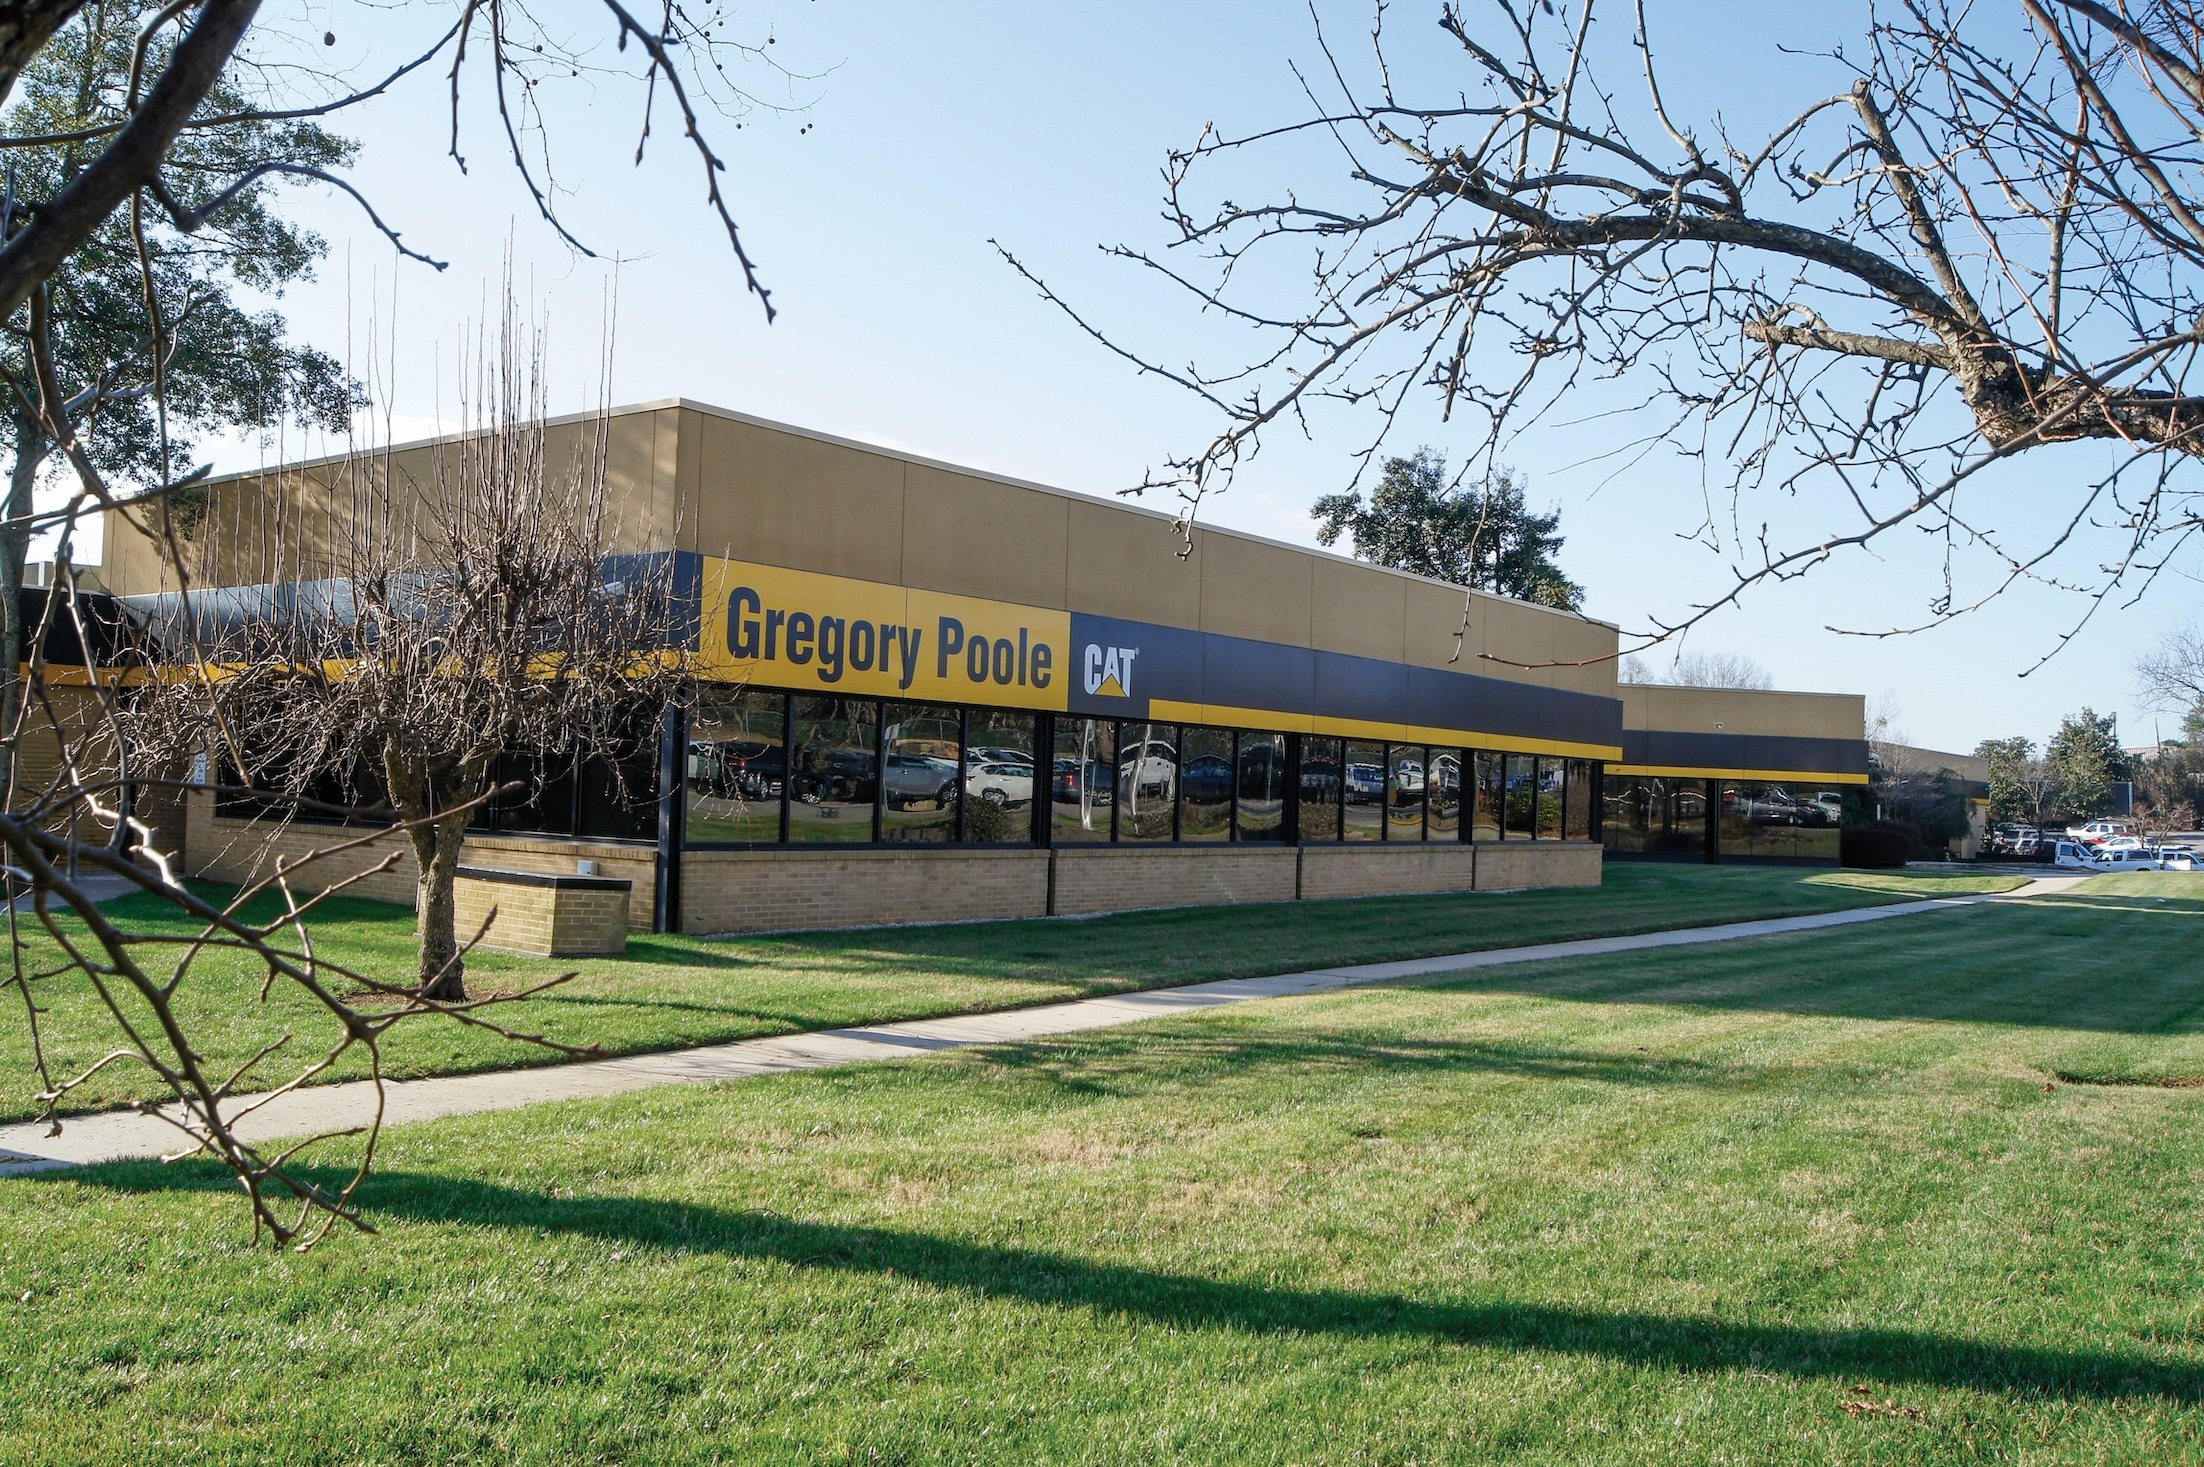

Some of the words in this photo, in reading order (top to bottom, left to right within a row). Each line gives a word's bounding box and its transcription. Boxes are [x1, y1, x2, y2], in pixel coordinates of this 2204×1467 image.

[726, 586, 921, 690] Gregory
[937, 616, 1052, 689] Poole
[1084, 643, 1135, 697] CAT
